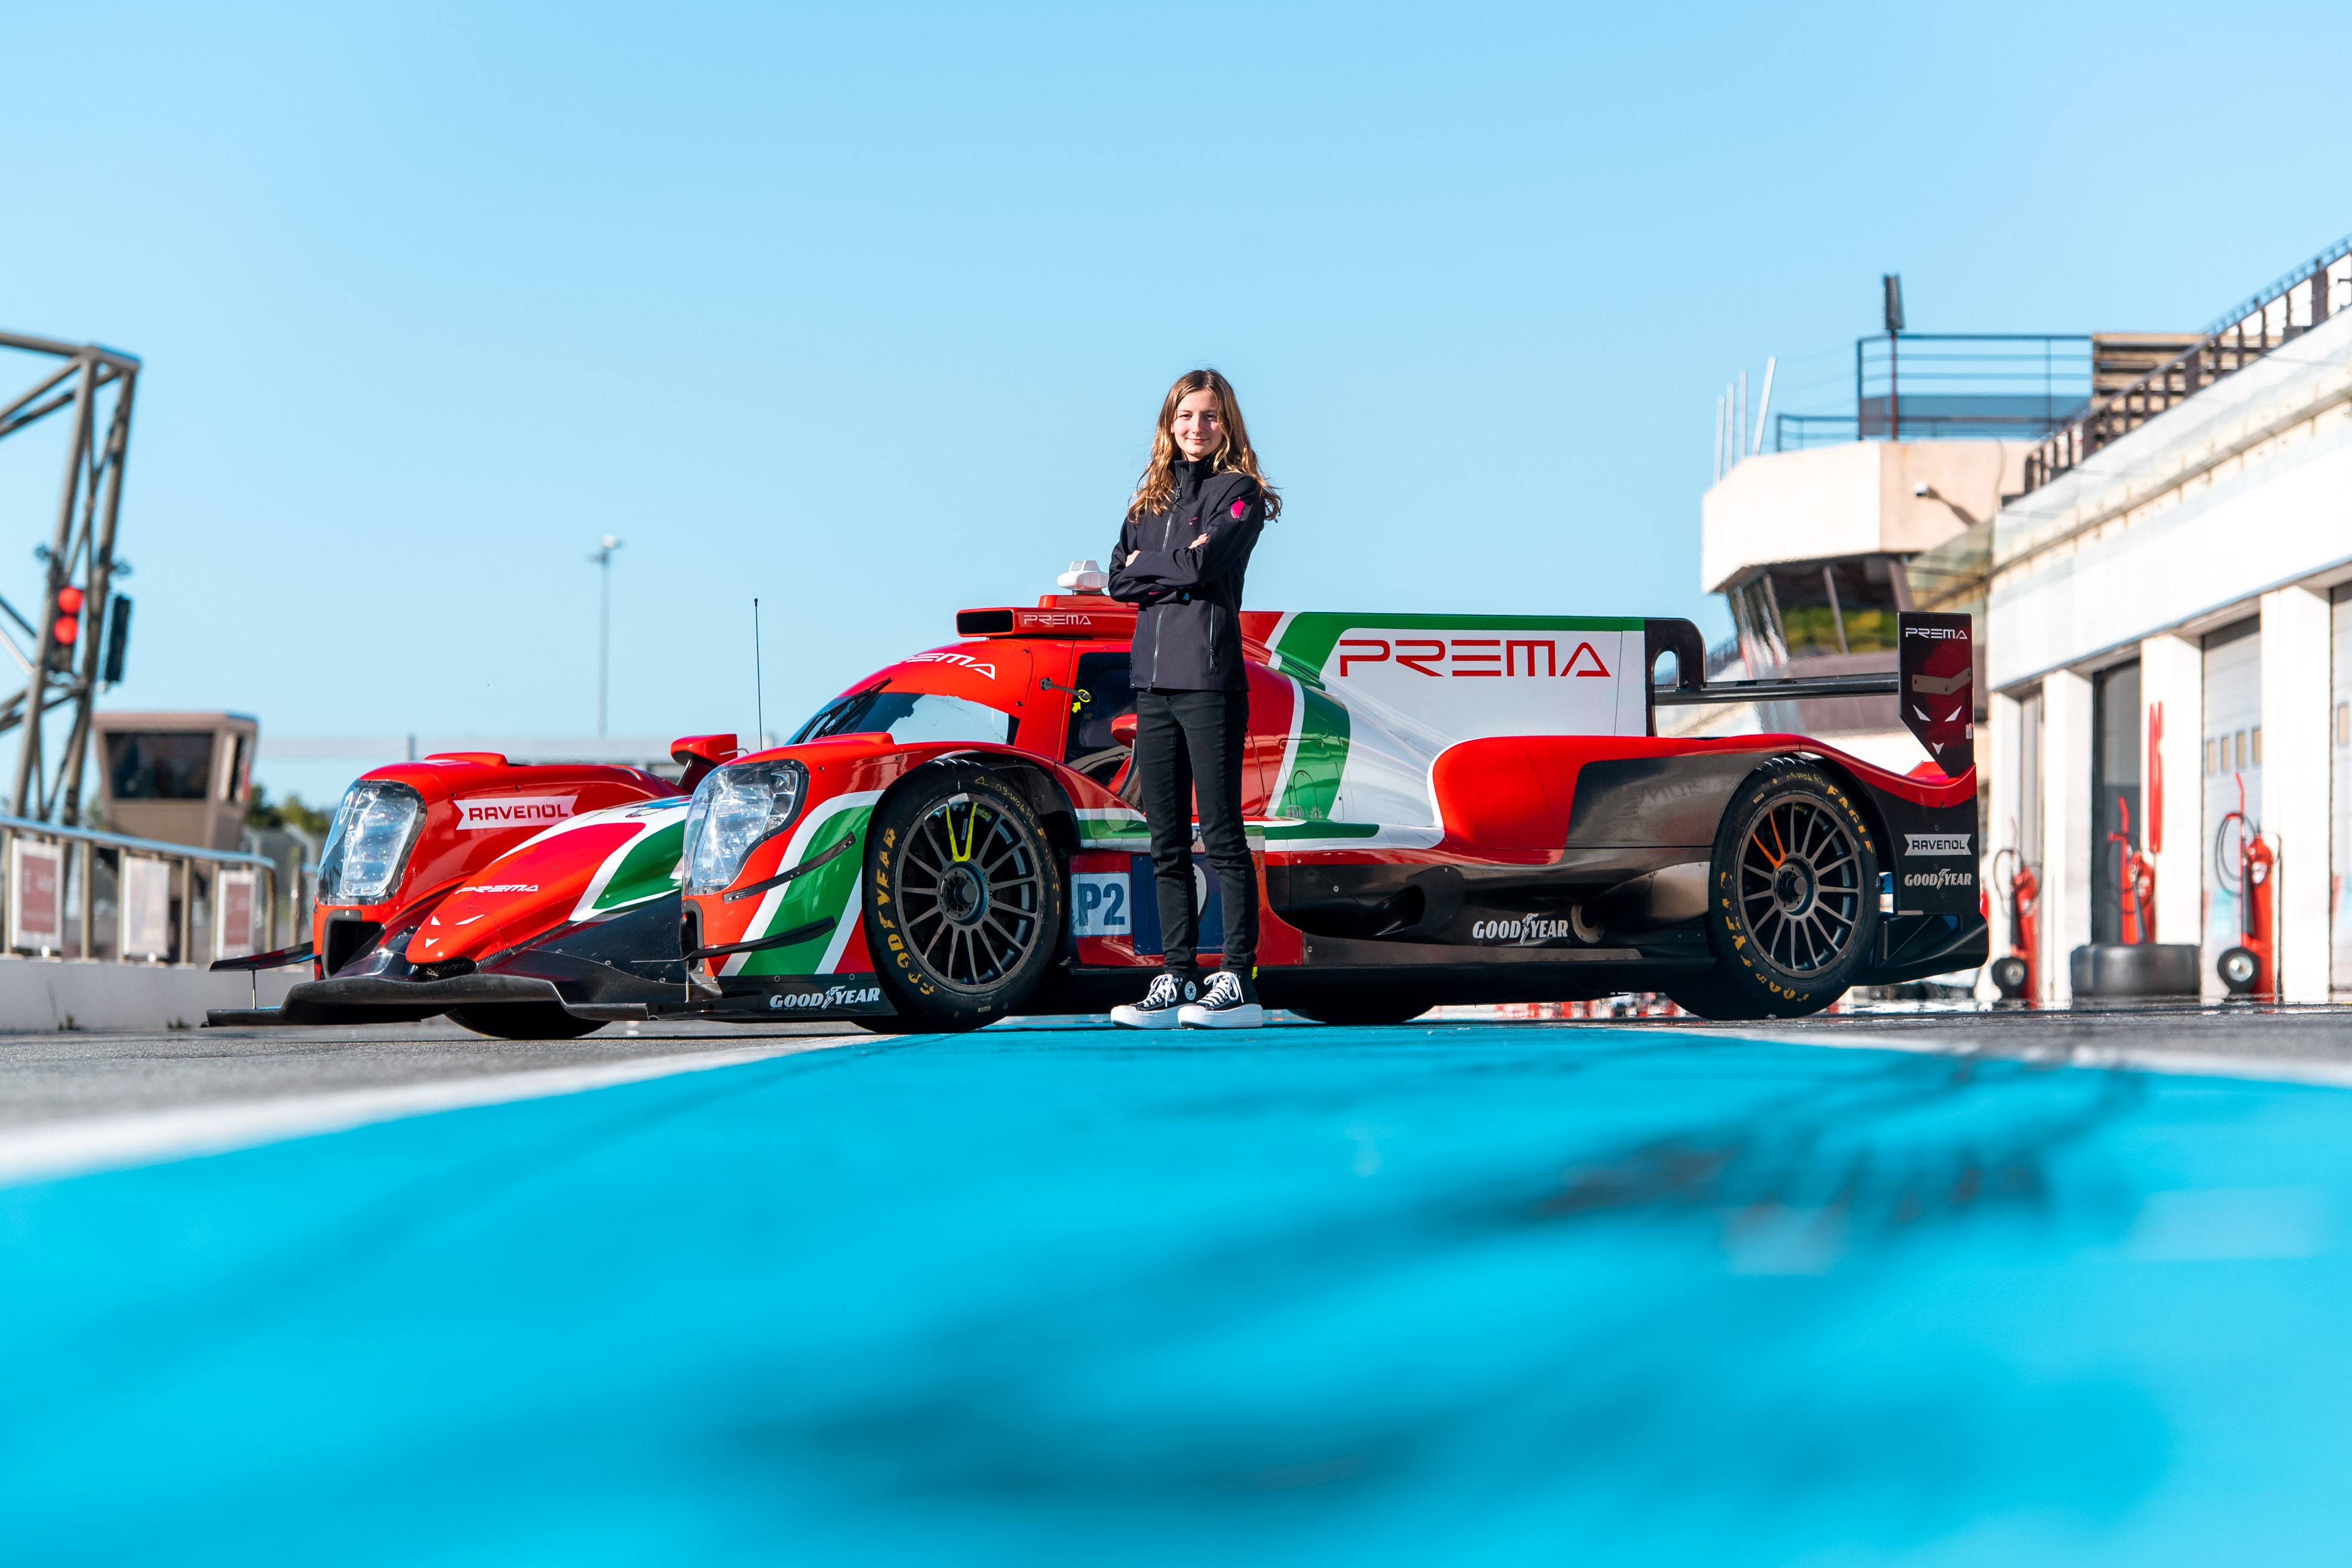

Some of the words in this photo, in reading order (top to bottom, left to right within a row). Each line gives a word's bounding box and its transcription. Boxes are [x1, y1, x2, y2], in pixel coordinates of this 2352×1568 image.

[1024, 614, 1092, 625] PREMA
[1905, 627, 1968, 640] PREMA
[890, 653, 995, 680] EMA
[1339, 639, 1612, 677] PREMA
[468, 804, 569, 821] RAVENOL
[1912, 840, 1965, 850] RAVENOL
[1904, 871, 1972, 887] GOODYEAR
[454, 884, 539, 895] PREMA
[1077, 882, 1125, 927] P2
[1472, 917, 1569, 941] GOODYEAR
[769, 987, 881, 1009] GOODYEAR
